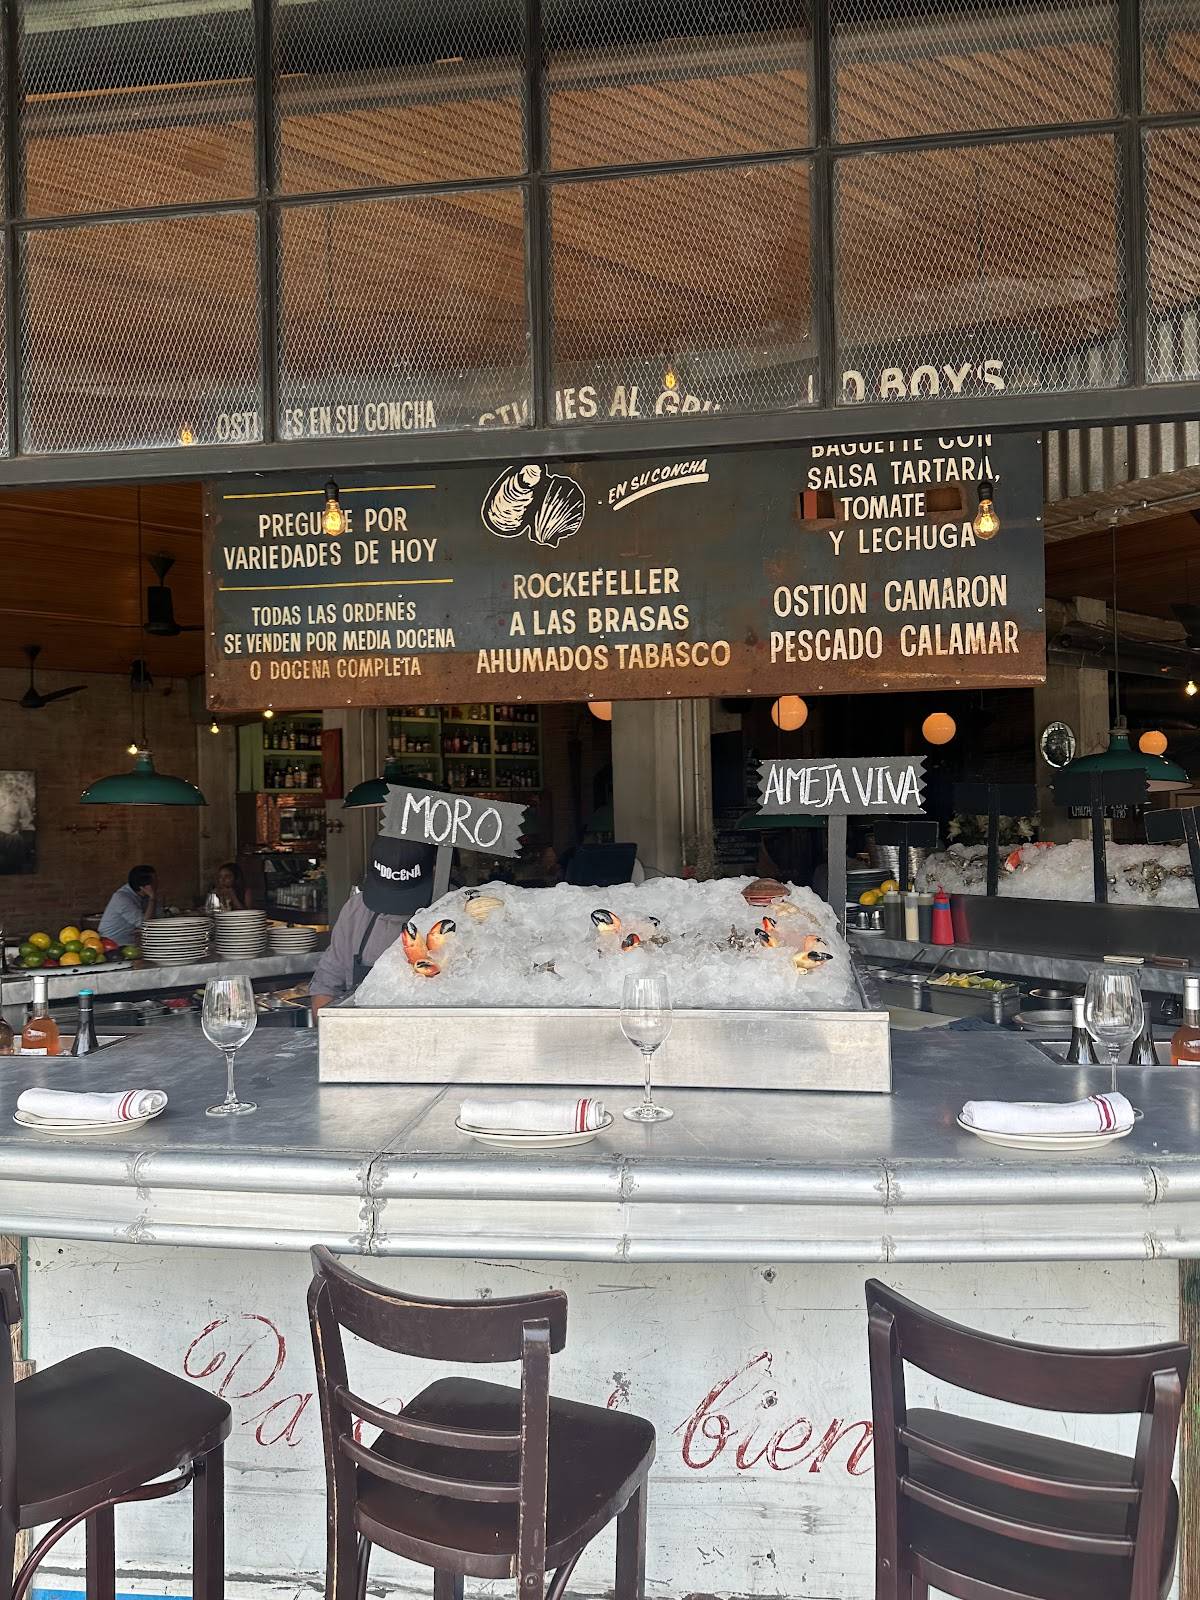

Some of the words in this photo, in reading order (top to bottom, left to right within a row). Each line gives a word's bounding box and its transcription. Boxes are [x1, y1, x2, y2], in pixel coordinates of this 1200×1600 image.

[609, 386, 640, 417] AL
[216, 408, 303, 440] OSTIES
[310, 407, 331, 435] EN
[336, 405, 359, 433] SU
[365, 401, 436, 432] CONCHA
[608, 481, 628, 504] EN
[631, 471, 651, 490] SU
[651, 459, 707, 482] CONCHA
[807, 463, 878, 490] SALSA
[890, 456, 1000, 484] TARTARA,
[259, 509, 353, 538] PREGUE
[365, 507, 409, 532] POR
[840, 492, 925, 521] TOMATE
[224, 541, 342, 570] VARIEDADES
[354, 539, 379, 565] DE
[391, 538, 438, 564] HOY
[828, 530, 845, 556] Y
[859, 522, 976, 554] LECHUGA
[513, 567, 680, 600] ROCKEFELLER
[773, 582, 867, 618] OSTION
[884, 574, 1008, 613] CAMARON
[252, 605, 301, 626] TODAS
[307, 603, 337, 625] LAS
[342, 601, 416, 623] ORDENES
[509, 611, 526, 636] A
[533, 608, 576, 636] LAS
[588, 604, 689, 634] BRASAS
[224, 633, 242, 654] SE
[246, 632, 301, 653] VENDEN
[306, 631, 337, 652] POR
[342, 630, 391, 651] MEDIA
[396, 628, 455, 649] DOCENA
[476, 644, 608, 674] AHUMADOS
[614, 640, 731, 670] TABASCO
[770, 626, 883, 664] PESCADO
[900, 620, 1019, 658] CALAMAR
[250, 660, 262, 681] O
[270, 659, 331, 680] DOCENA
[336, 656, 422, 679] COMPLETA
[763, 763, 850, 808] ALMEJA
[851, 765, 922, 807] VIVA
[400, 792, 503, 847] MORO
[380, 863, 421, 880] DOCENA
